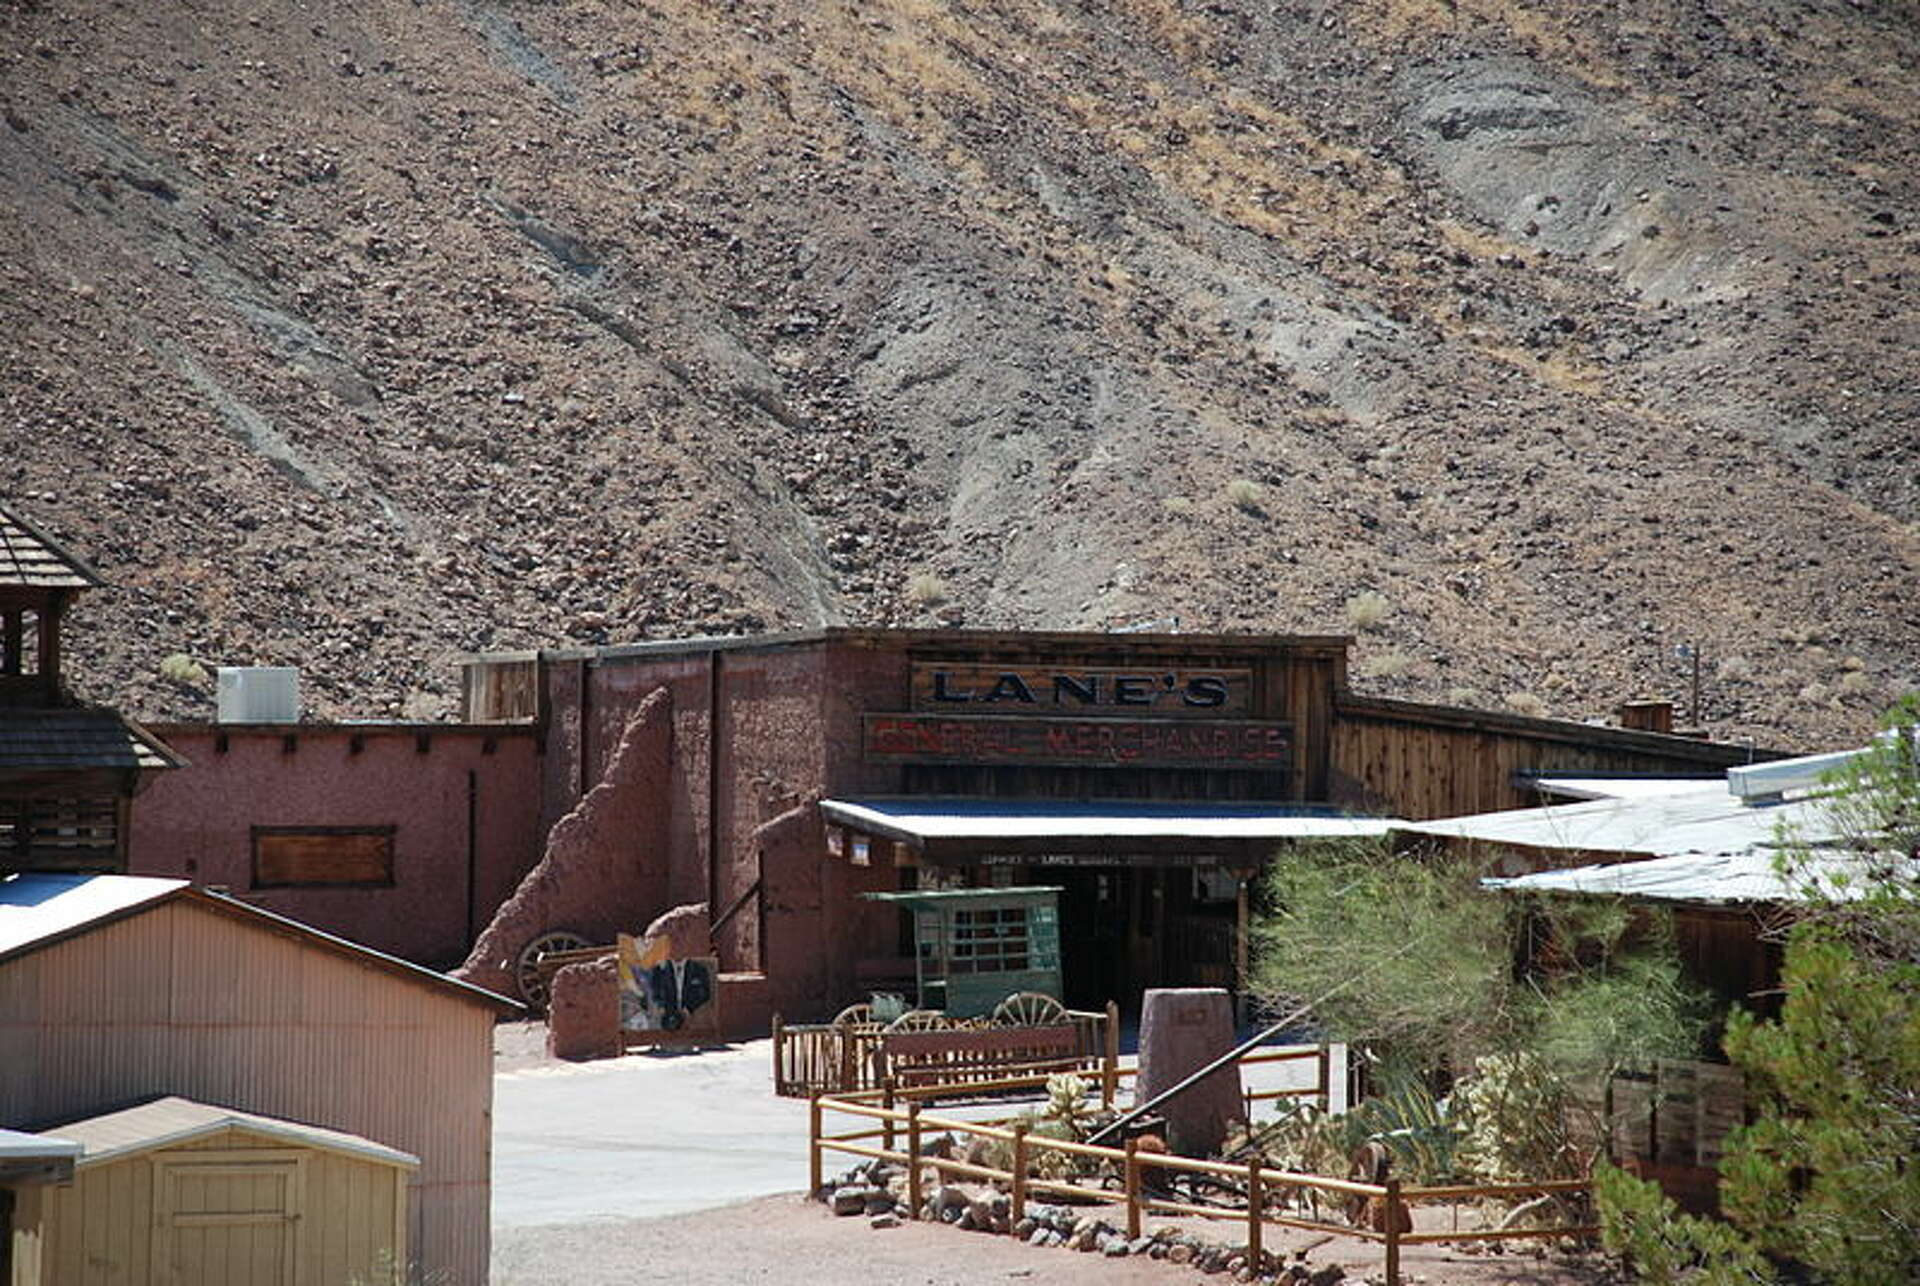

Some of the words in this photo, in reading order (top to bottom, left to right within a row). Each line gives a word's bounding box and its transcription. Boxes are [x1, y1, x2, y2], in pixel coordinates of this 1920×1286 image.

[929, 671, 1230, 707] LANE'S
[872, 719, 1027, 757] GENERAL
[1046, 723, 1288, 763] MERCHANDISE
